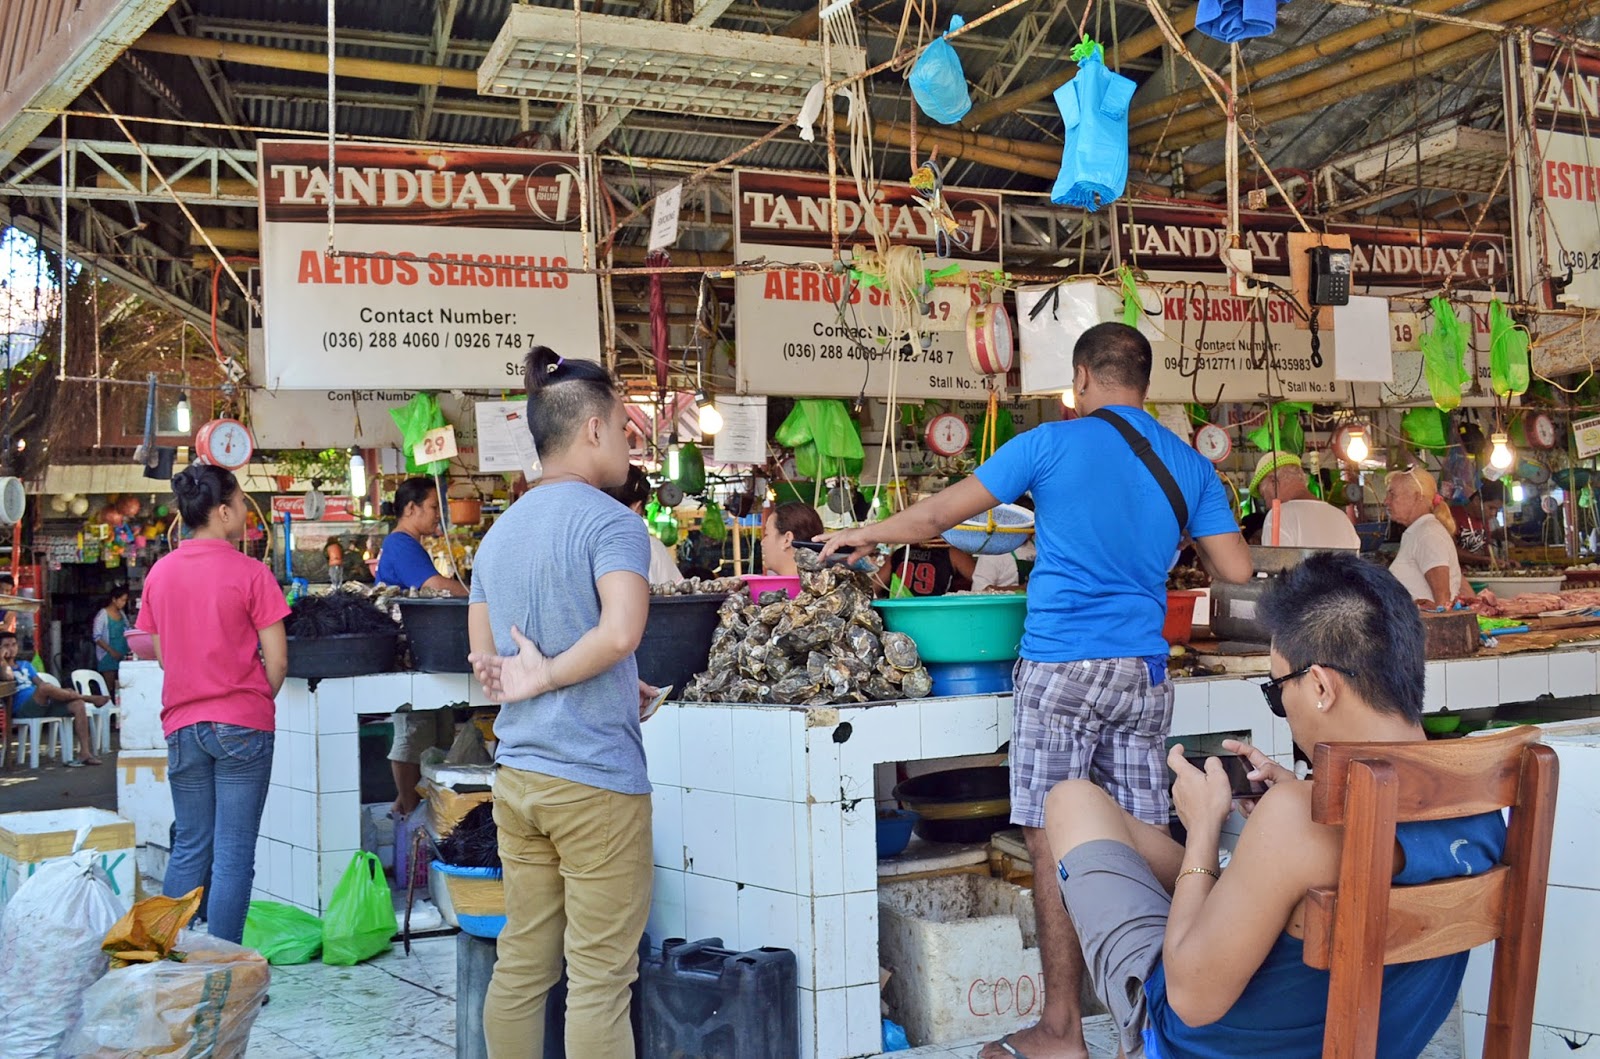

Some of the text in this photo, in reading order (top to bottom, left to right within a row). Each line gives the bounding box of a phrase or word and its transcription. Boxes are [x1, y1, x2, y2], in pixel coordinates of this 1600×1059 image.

[271, 164, 524, 211] TANDUAY
[1546, 160, 1600, 203] ESTE
[743, 191, 938, 241] TANDUAY
[298, 250, 569, 289] AEROS SEASHELLS
[1352, 244, 1469, 276] ANDUAY
[360, 307, 517, 325] Contact Number:
[928, 301, 951, 321] 19
[323, 331, 363, 351] (036)
[369, 332, 397, 348] 288
[403, 332, 440, 349] 4060
[454, 333, 491, 349] 0926
[496, 334, 522, 349] 748
[1394, 324, 1413, 342] 18
[783, 343, 816, 362] (036)
[820, 344, 843, 359] 288
[922, 347, 946, 363] 748
[947, 350, 954, 364] 7
[505, 362, 526, 376] Sta
[929, 375, 953, 388] Stall
[956, 376, 977, 390] No.:
[1287, 381, 1336, 393] Stall No.: 8
[378, 390, 415, 402] Numbe
[424, 435, 446, 455] 29
